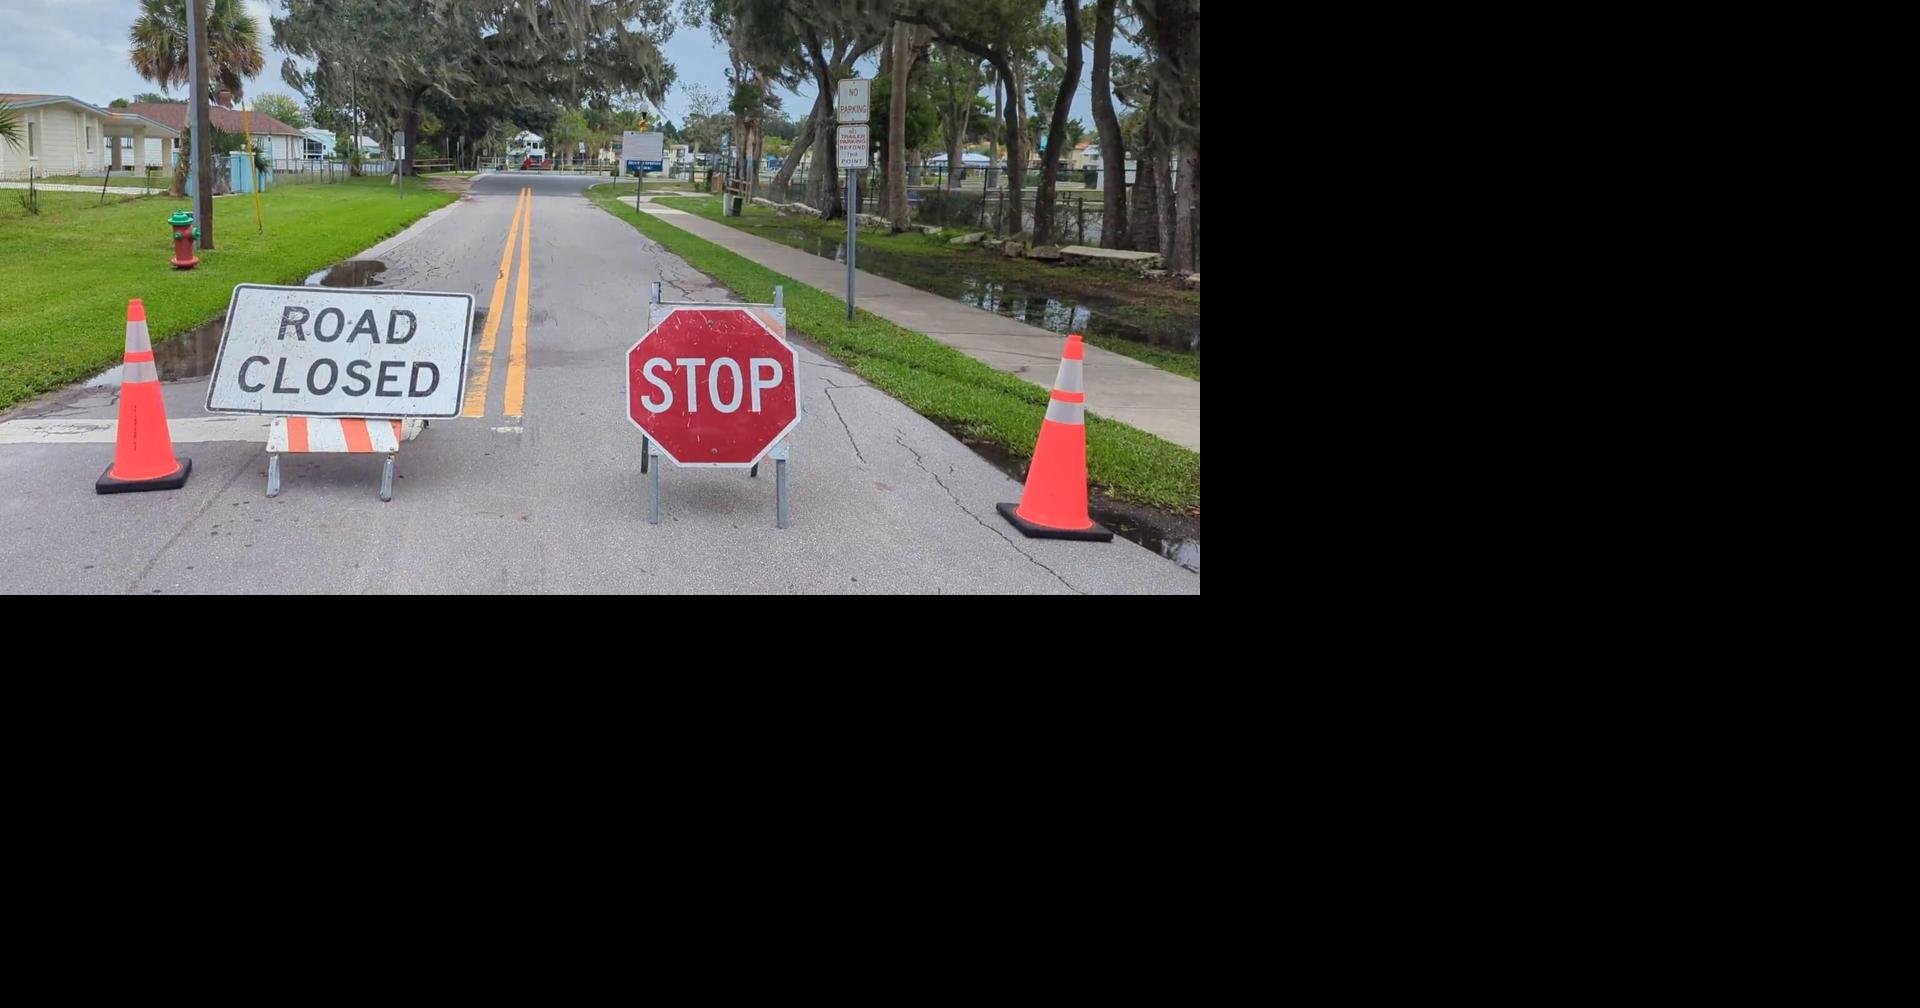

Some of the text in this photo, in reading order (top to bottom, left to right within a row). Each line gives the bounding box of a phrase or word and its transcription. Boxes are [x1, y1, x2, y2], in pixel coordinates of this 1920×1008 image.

[840, 105, 866, 113] PARKING
[849, 88, 858, 96] NO
[277, 305, 418, 345] ROAD
[238, 355, 441, 398] CLOSED
[640, 357, 783, 413] STOP
